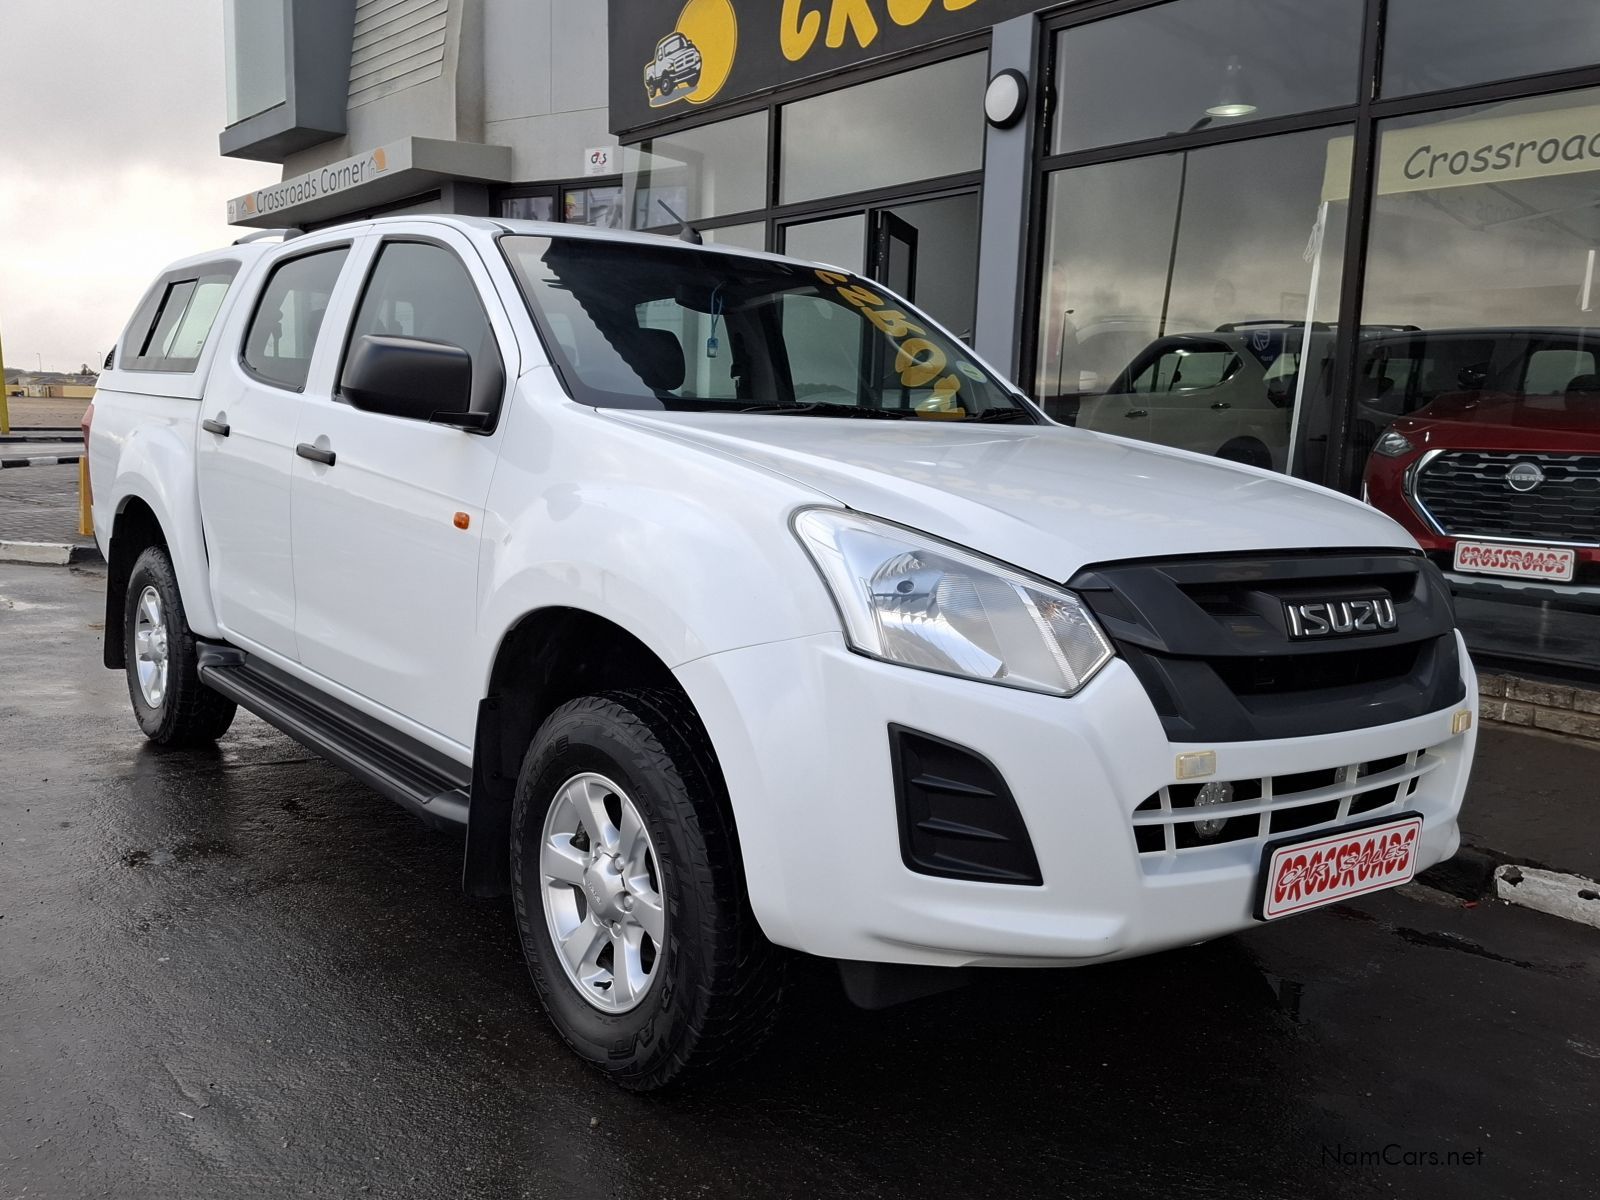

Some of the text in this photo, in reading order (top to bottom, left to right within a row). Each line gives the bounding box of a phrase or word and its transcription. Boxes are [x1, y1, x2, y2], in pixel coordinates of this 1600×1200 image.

[256, 174, 316, 213] Crossroads
[321, 159, 366, 194] Corner
[1505, 473, 1545, 482] NISSAN
[1459, 546, 1569, 574] CROSSROADS
[1288, 599, 1397, 636] ISUZU
[1274, 828, 1416, 903] CROSSROADS
[1280, 842, 1410, 887] CAR SALES
